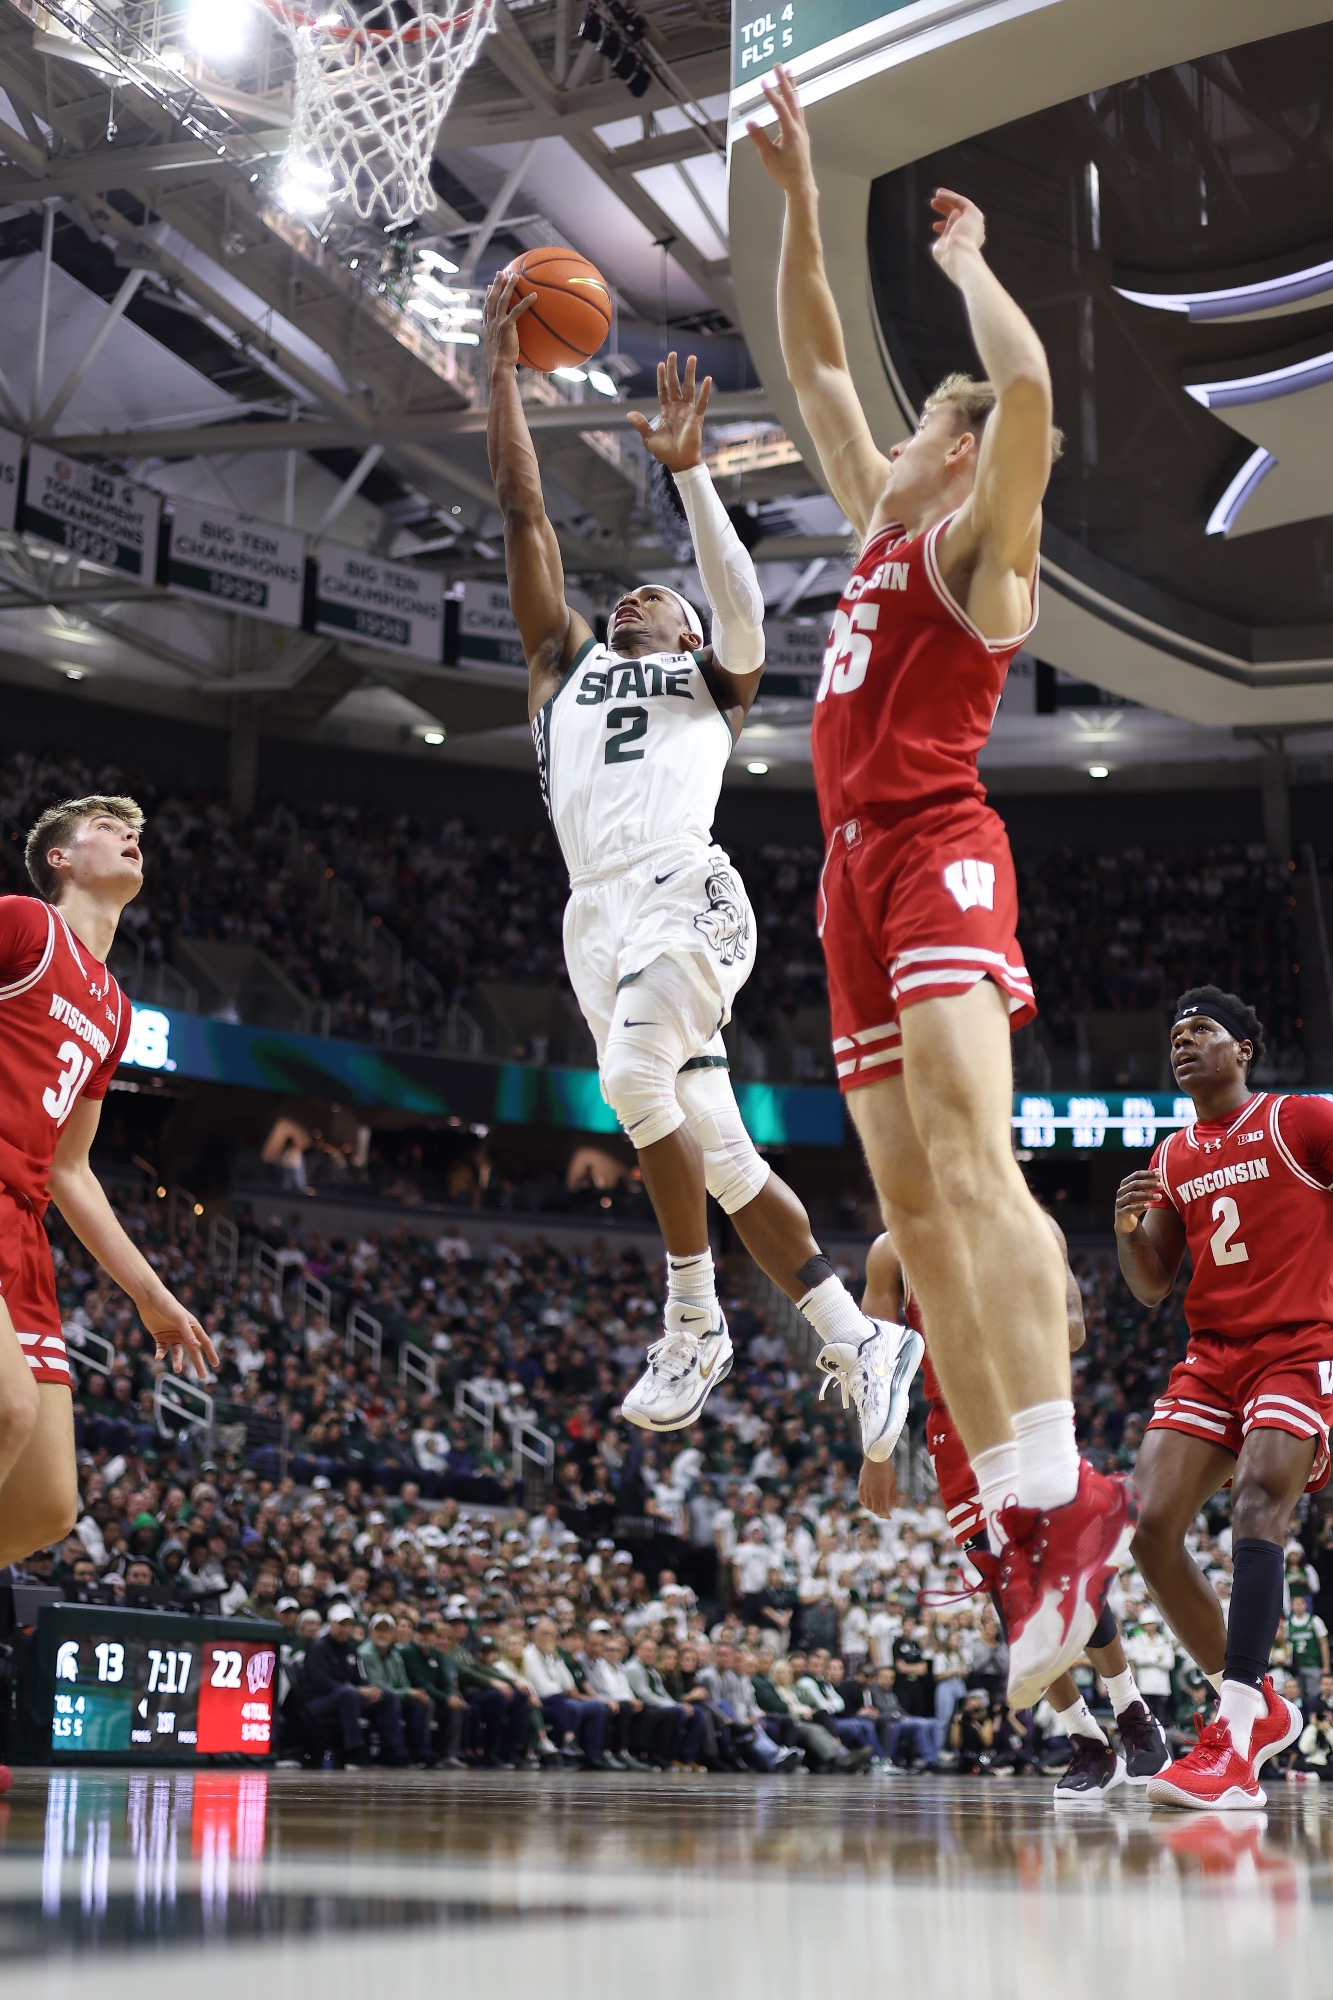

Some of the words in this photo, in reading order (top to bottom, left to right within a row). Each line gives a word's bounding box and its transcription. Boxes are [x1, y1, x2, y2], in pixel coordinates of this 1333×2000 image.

[741, 13, 776, 43] TOL
[781, 3, 794, 21] 4
[741, 36, 775, 69] FLS
[782, 28, 793, 48] 5
[42, 493, 143, 544] CHAMPIONS
[201, 521, 234, 544] BIG
[242, 531, 279, 555] TEN
[176, 536, 299, 583] CHAMPIONS
[346, 560, 378, 582] BIG
[384, 569, 419, 592] TEN
[323, 576, 439, 618] CHAMPIONS
[576, 661, 694, 705] STATE
[605, 706, 648, 765] 2
[944, 859, 996, 912] W
[42, 1041, 93, 1128] 31
[1176, 1157, 1270, 1205] WISCONSIN
[1210, 1196, 1249, 1266] 2
[95, 1642, 125, 1682] 13
[147, 1650, 193, 1694] 7:17
[210, 1650, 242, 1688] 22
[74, 1696, 86, 1714] 4
[73, 1718, 83, 1736] 5
